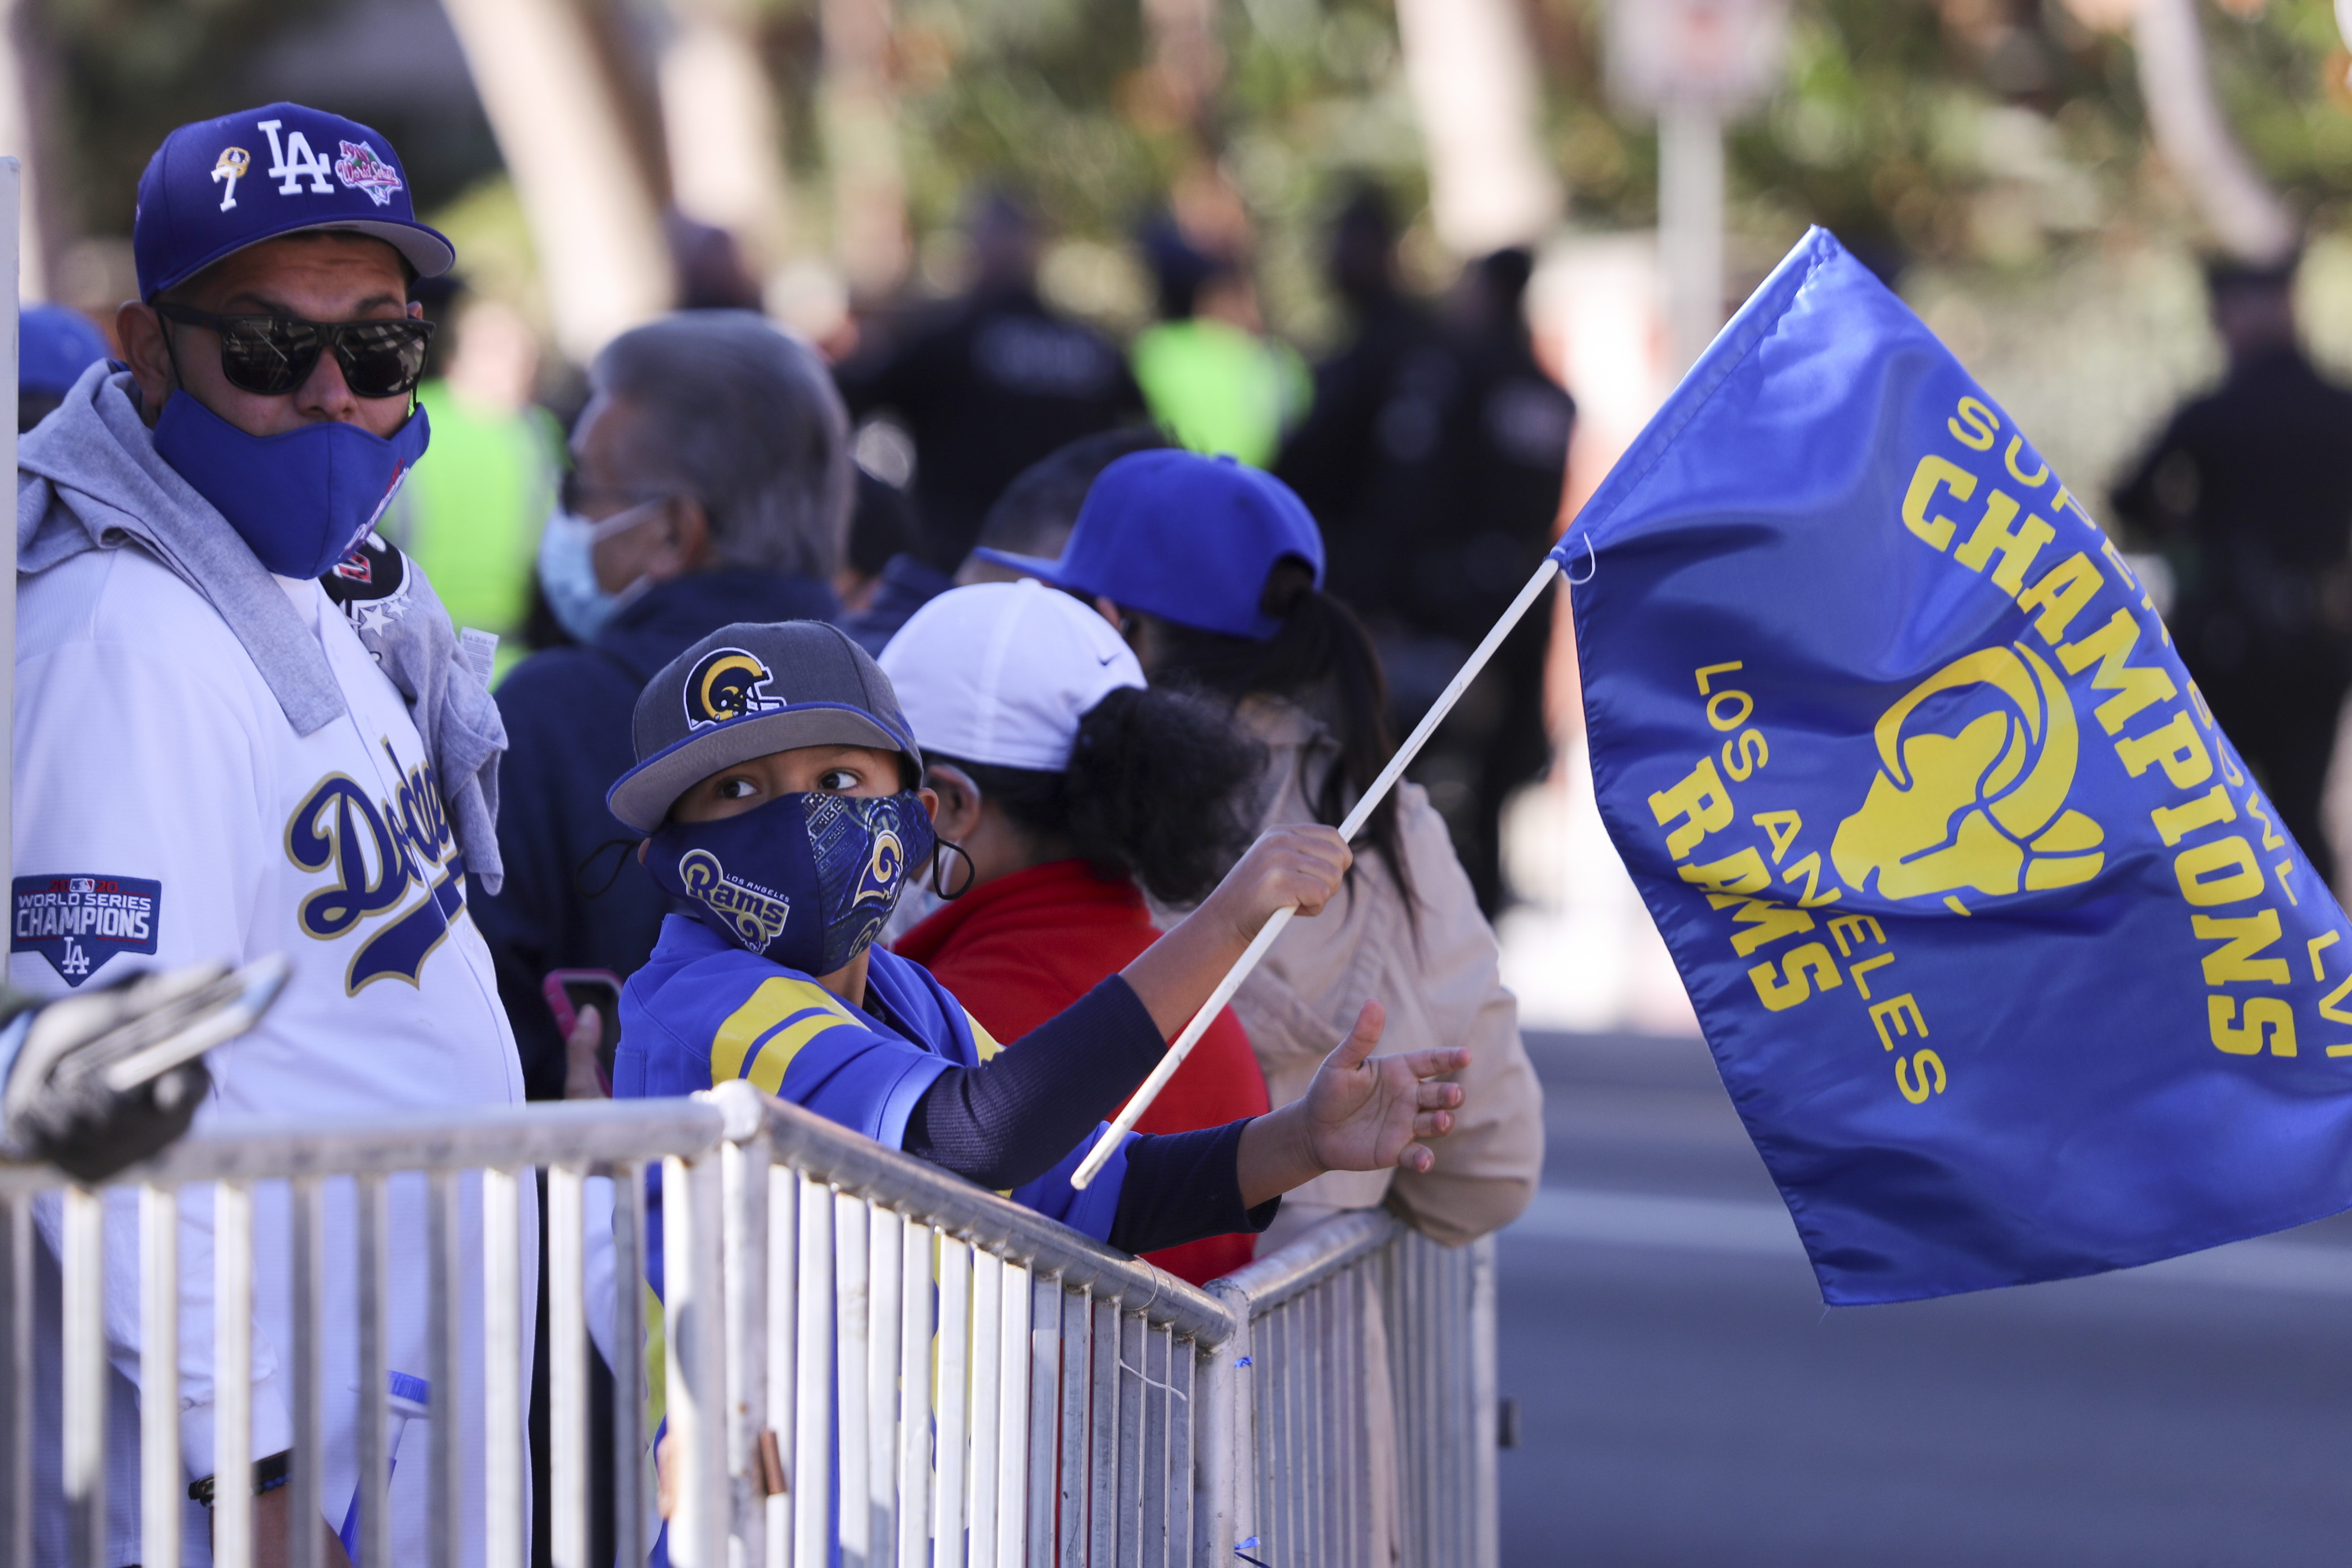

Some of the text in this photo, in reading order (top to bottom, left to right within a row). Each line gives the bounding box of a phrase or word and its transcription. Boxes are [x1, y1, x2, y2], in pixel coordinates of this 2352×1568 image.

[257, 119, 334, 195] LA
[335, 160, 372, 185] World
[211, 165, 237, 213] 7
[1902, 455, 2297, 1057] CHAMPIONS
[18, 893, 152, 911] WORLD SERIES
[681, 853, 786, 925] Rams
[726, 873, 790, 903] LOS ANGELES
[1648, 756, 1843, 1012] RAMS
[1695, 660, 1947, 1104] LOS ANELES
[16, 907, 151, 939] CHAMPIONS
[62, 936, 90, 974] LA
